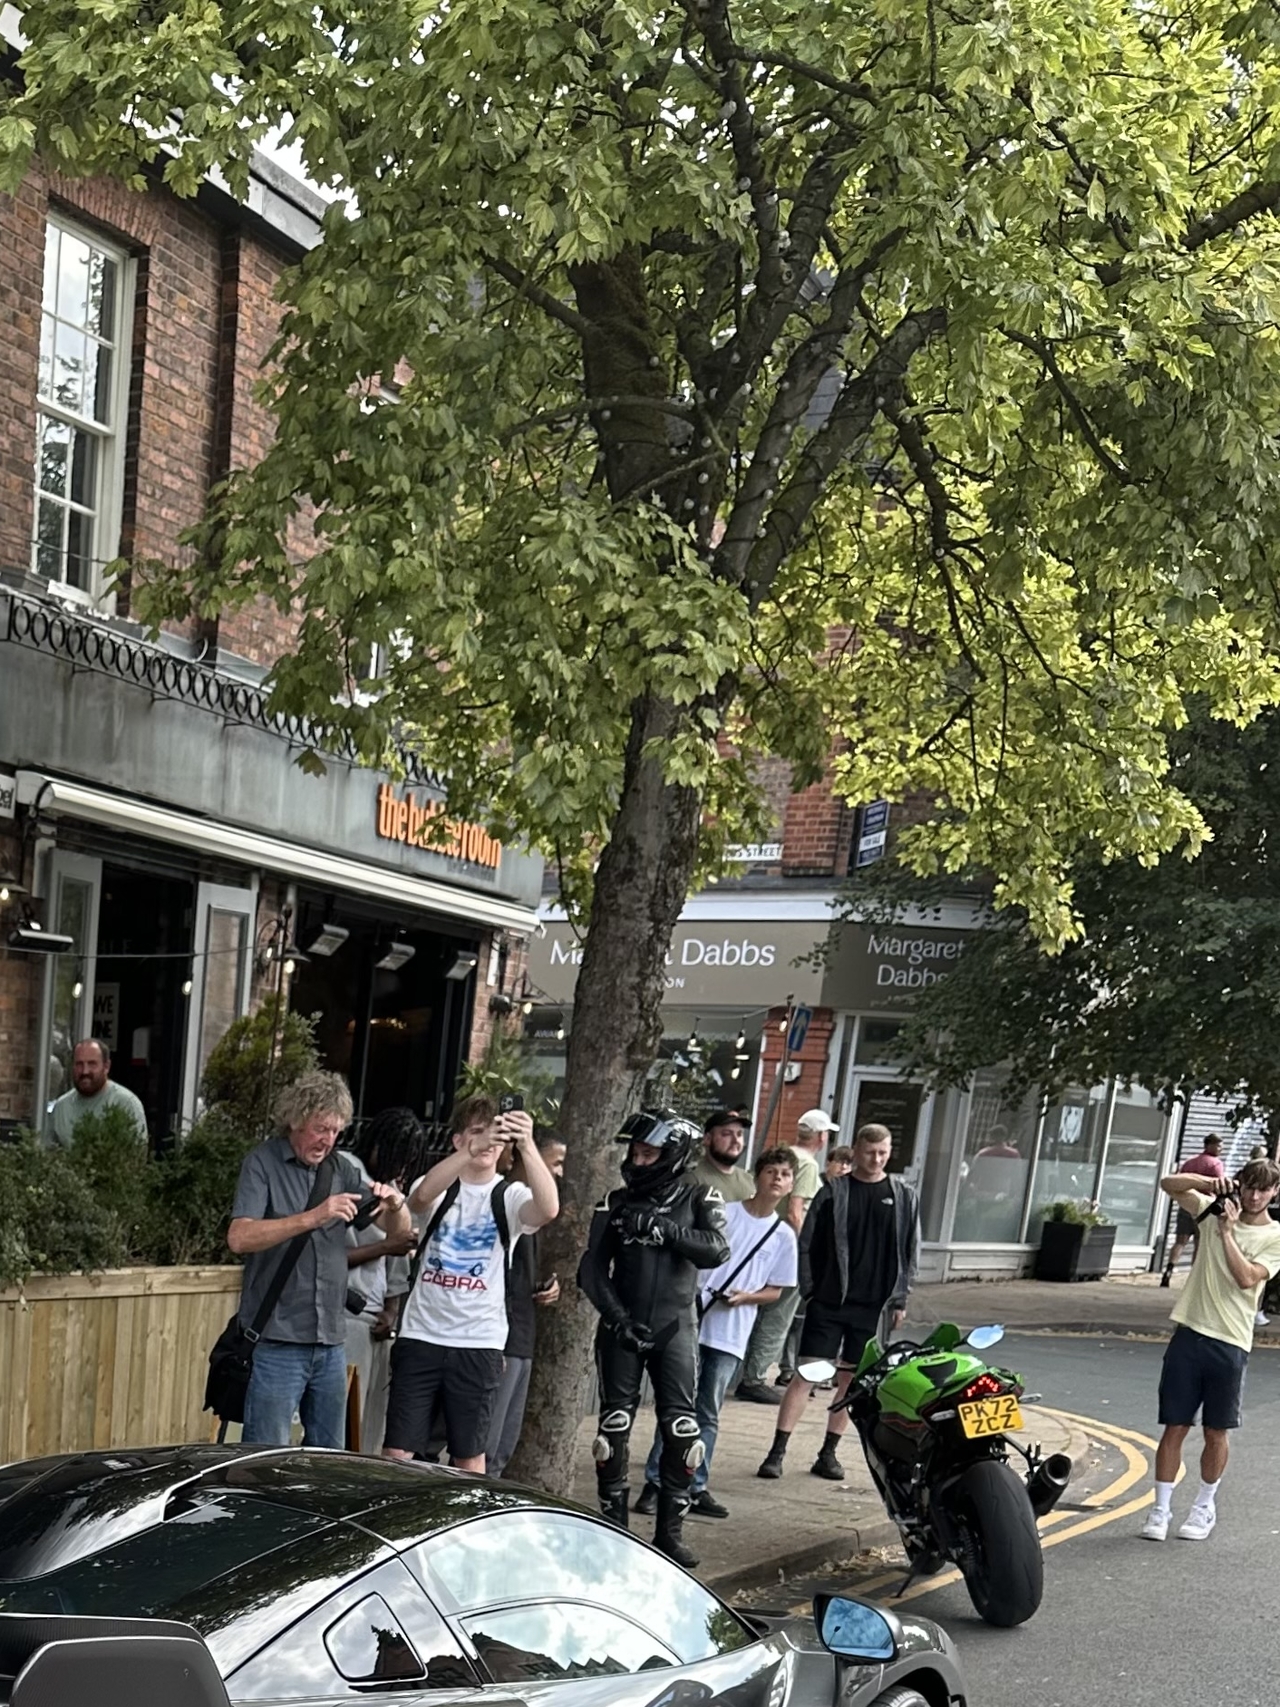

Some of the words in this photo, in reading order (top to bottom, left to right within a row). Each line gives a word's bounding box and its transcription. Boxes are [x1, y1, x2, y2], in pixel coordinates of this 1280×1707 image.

[681, 938, 776, 967] Dabbs
[867, 934, 966, 965] Margaret
[421, 1270, 488, 1291] COBRA
[960, 1397, 1018, 1421] PK72
[971, 1413, 1016, 1435] ZCZ
